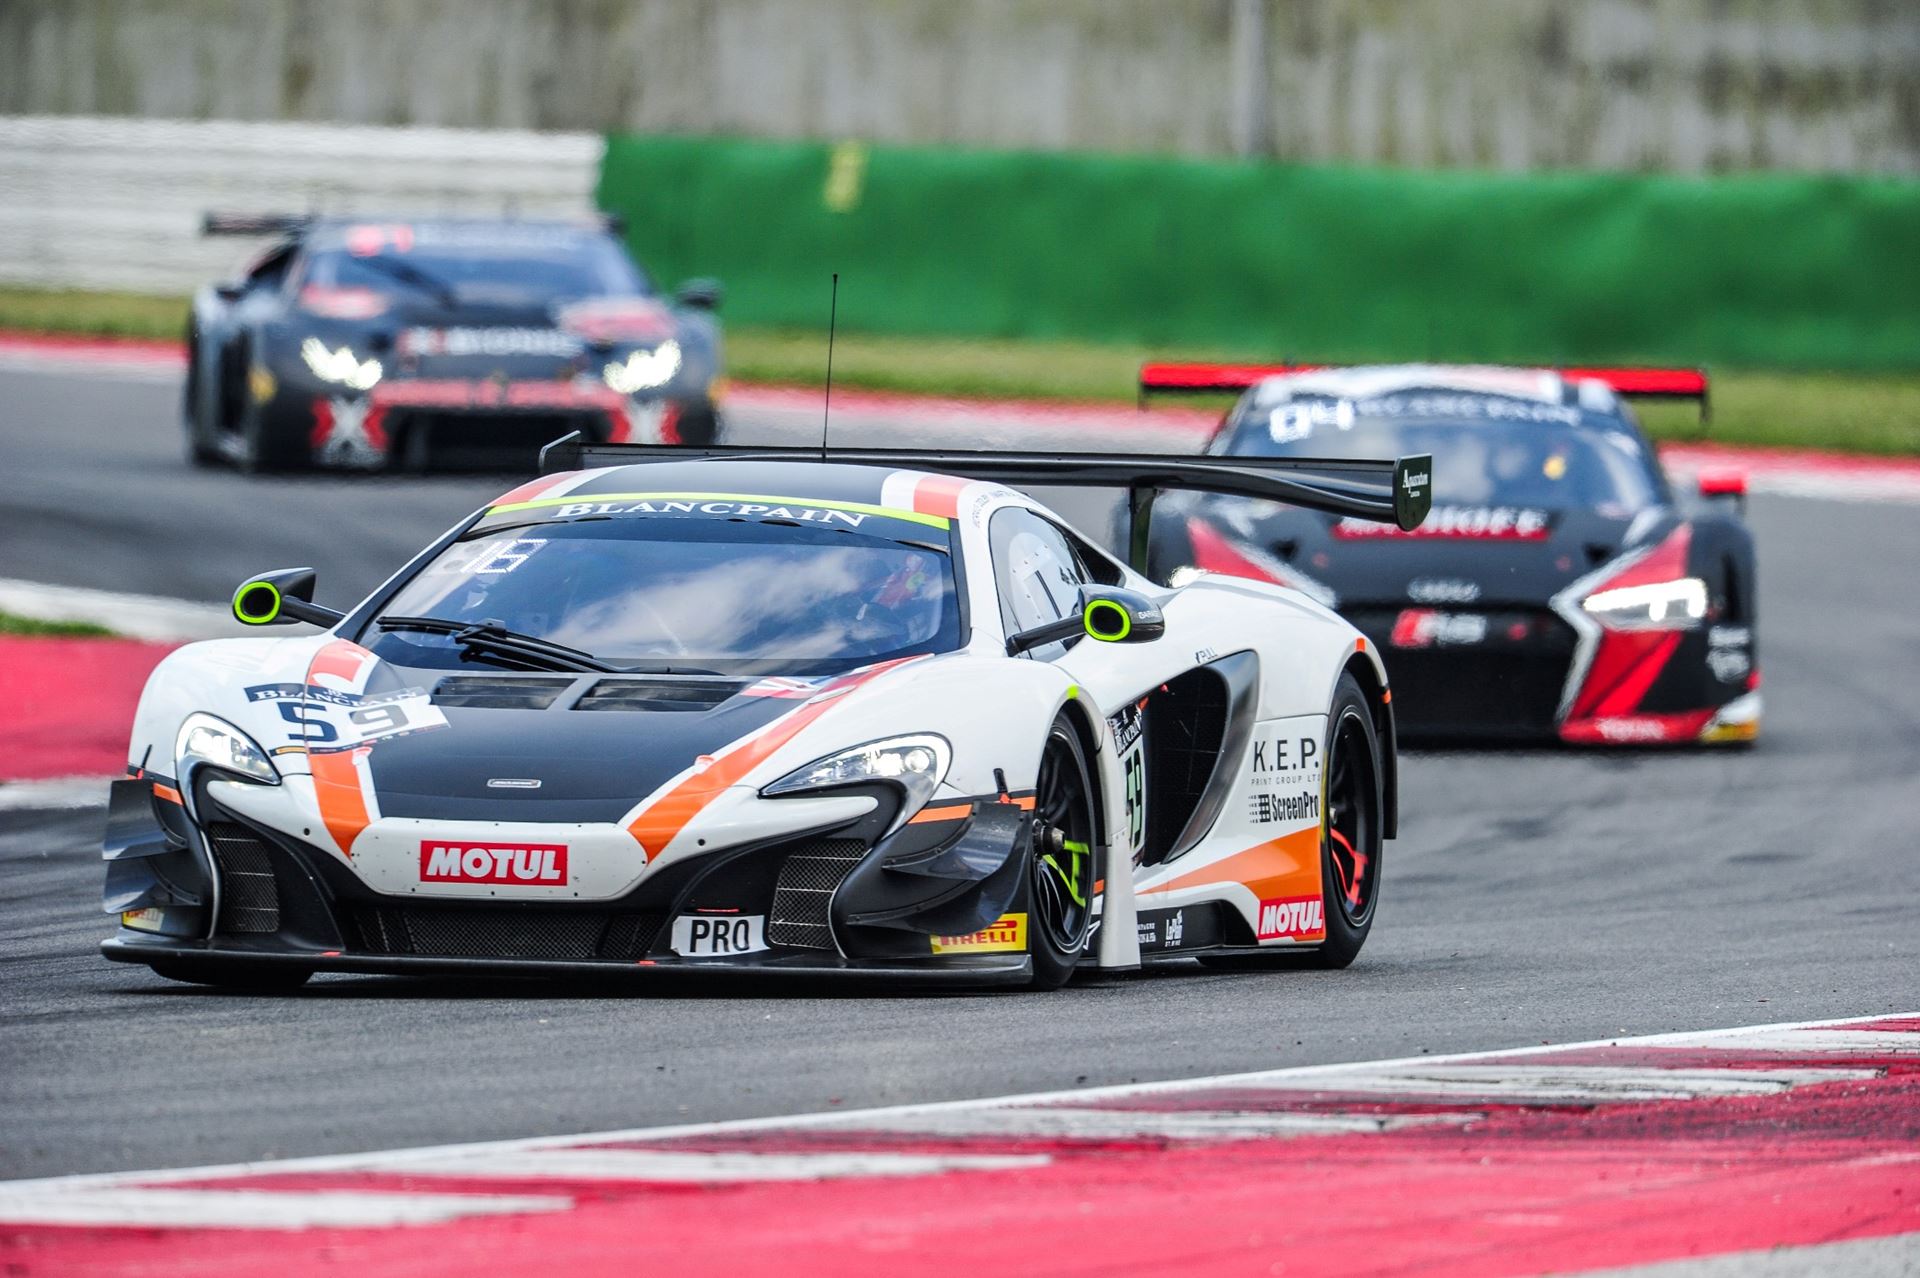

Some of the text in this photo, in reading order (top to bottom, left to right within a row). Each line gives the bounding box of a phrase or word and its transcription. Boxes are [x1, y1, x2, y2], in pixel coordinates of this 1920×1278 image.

[551, 502, 871, 528] BLANCPAIN
[276, 700, 410, 743] 59
[1252, 737, 1319, 773] K.E.P.
[1251, 777, 1272, 786] PRINT
[1276, 775, 1302, 785] GROUP
[1271, 791, 1319, 822] ScreenPro
[426, 847, 562, 880] MOTUL
[1260, 900, 1323, 935] MOTUL
[689, 919, 750, 953] PRO
